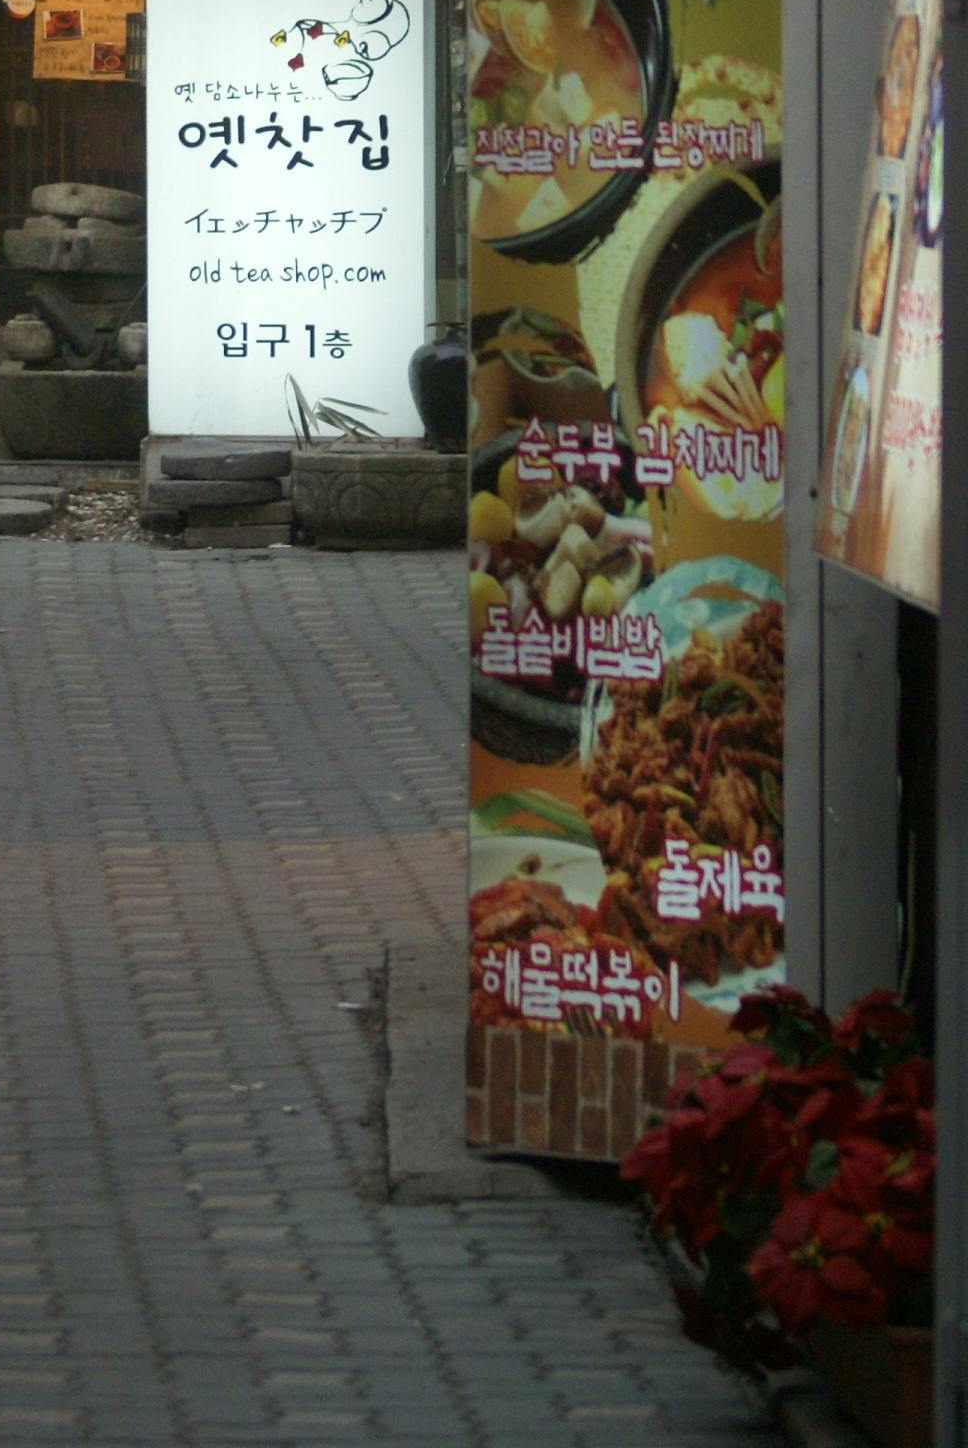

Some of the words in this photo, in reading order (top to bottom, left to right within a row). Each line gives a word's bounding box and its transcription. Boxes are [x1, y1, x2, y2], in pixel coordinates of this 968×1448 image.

[178, 112, 390, 171] 옛찻집
[589, 119, 644, 169] 만든
[189, 260, 222, 284] old
[230, 261, 273, 282] tea
[216, 321, 290, 359] 입구
[303, 323, 352, 359] 1층
[517, 416, 621, 483] 순두부
[481, 605, 662, 681] 돌솥비빔밥
[657, 837, 786, 925] 돌제육
[482, 940, 680, 1022] 해물떡볶이
